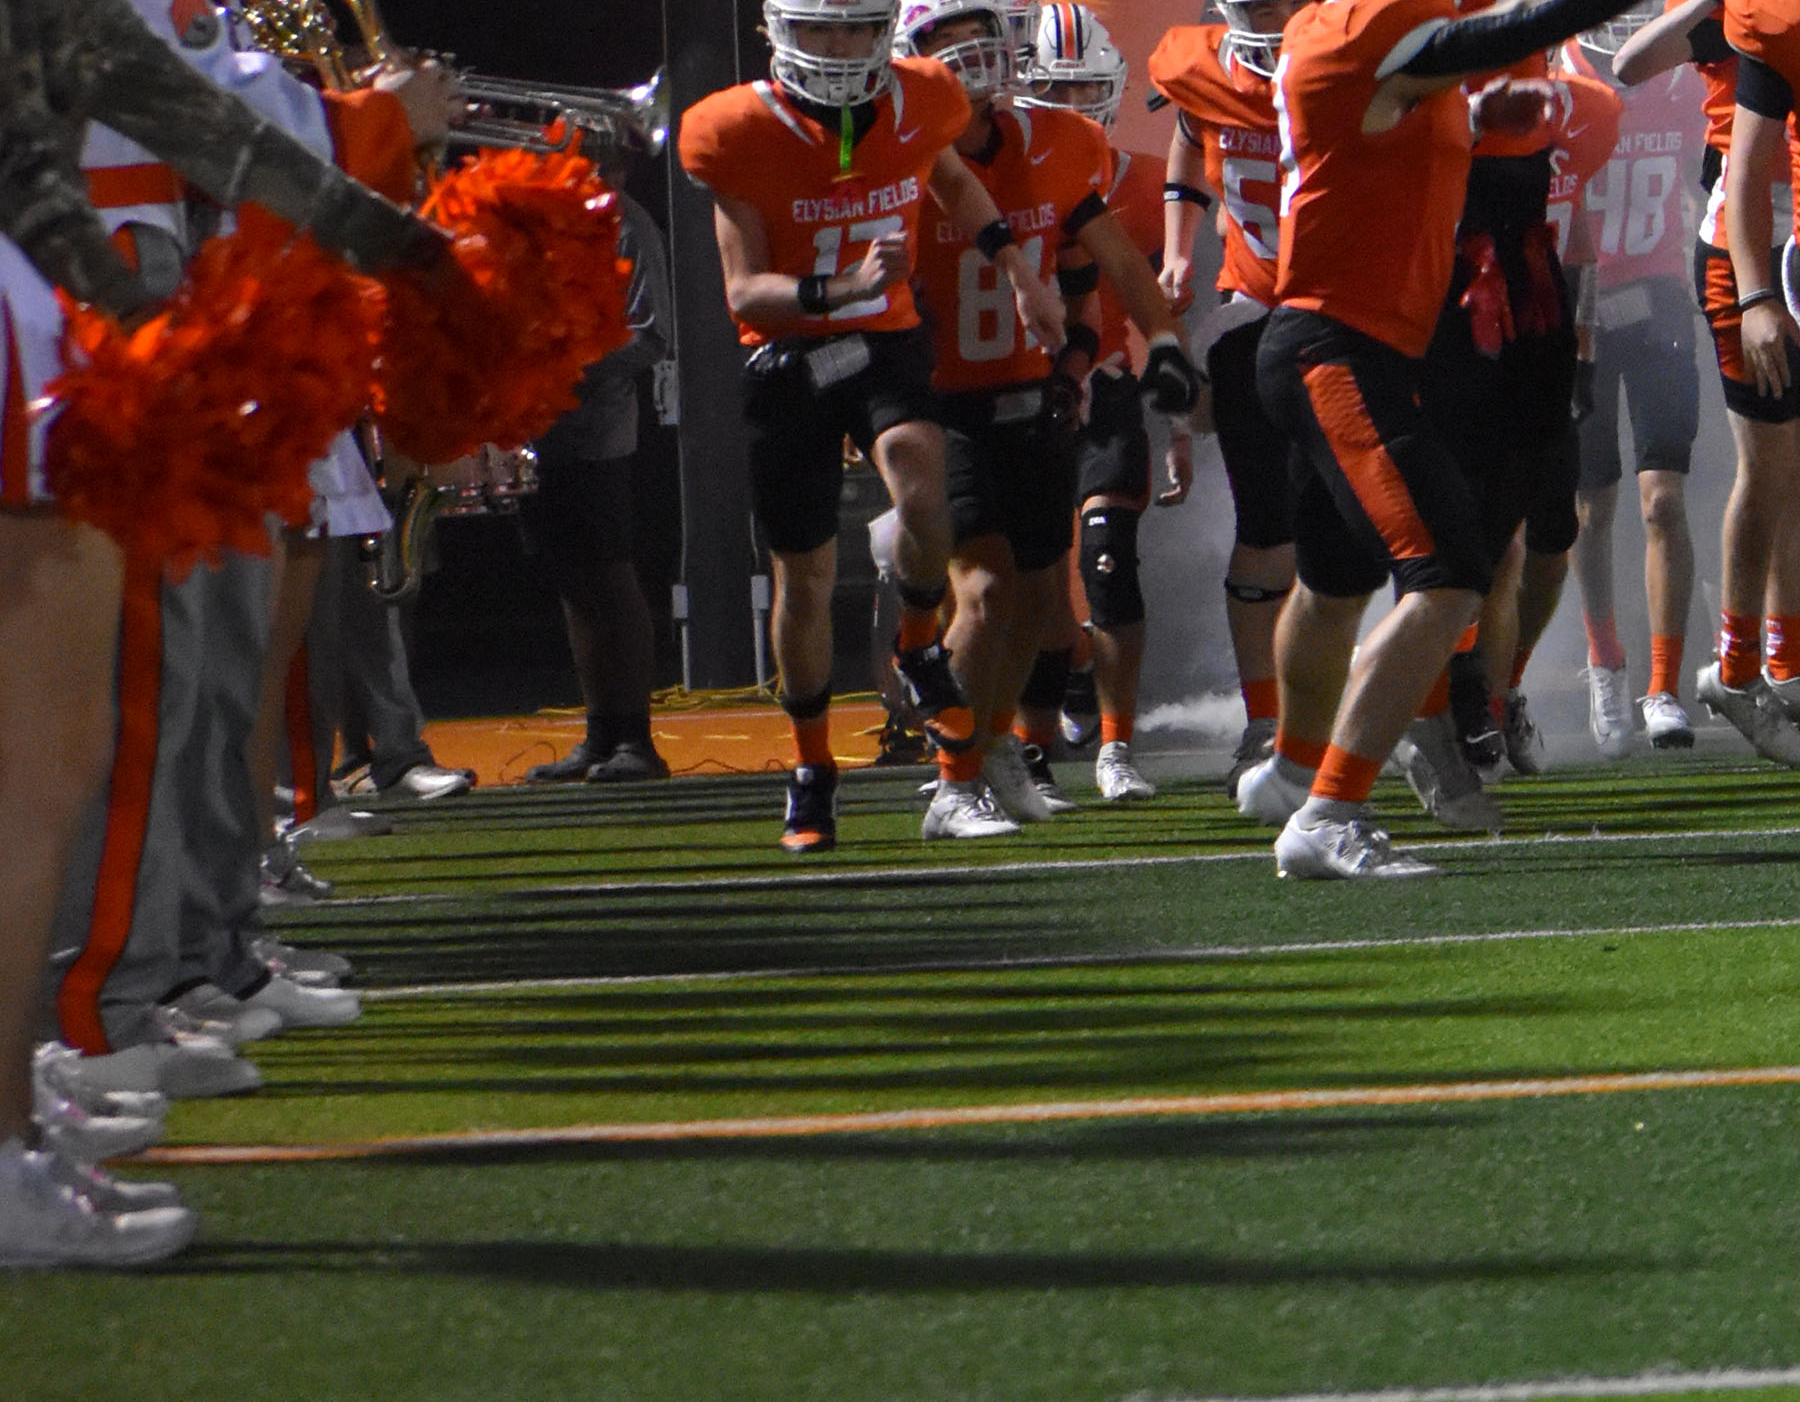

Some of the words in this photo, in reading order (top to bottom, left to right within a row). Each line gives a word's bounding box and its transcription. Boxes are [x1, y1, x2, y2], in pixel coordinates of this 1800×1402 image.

[1634, 130, 1683, 153] FIELDS
[868, 175, 919, 215] FIELDS
[1585, 156, 1677, 256] 48
